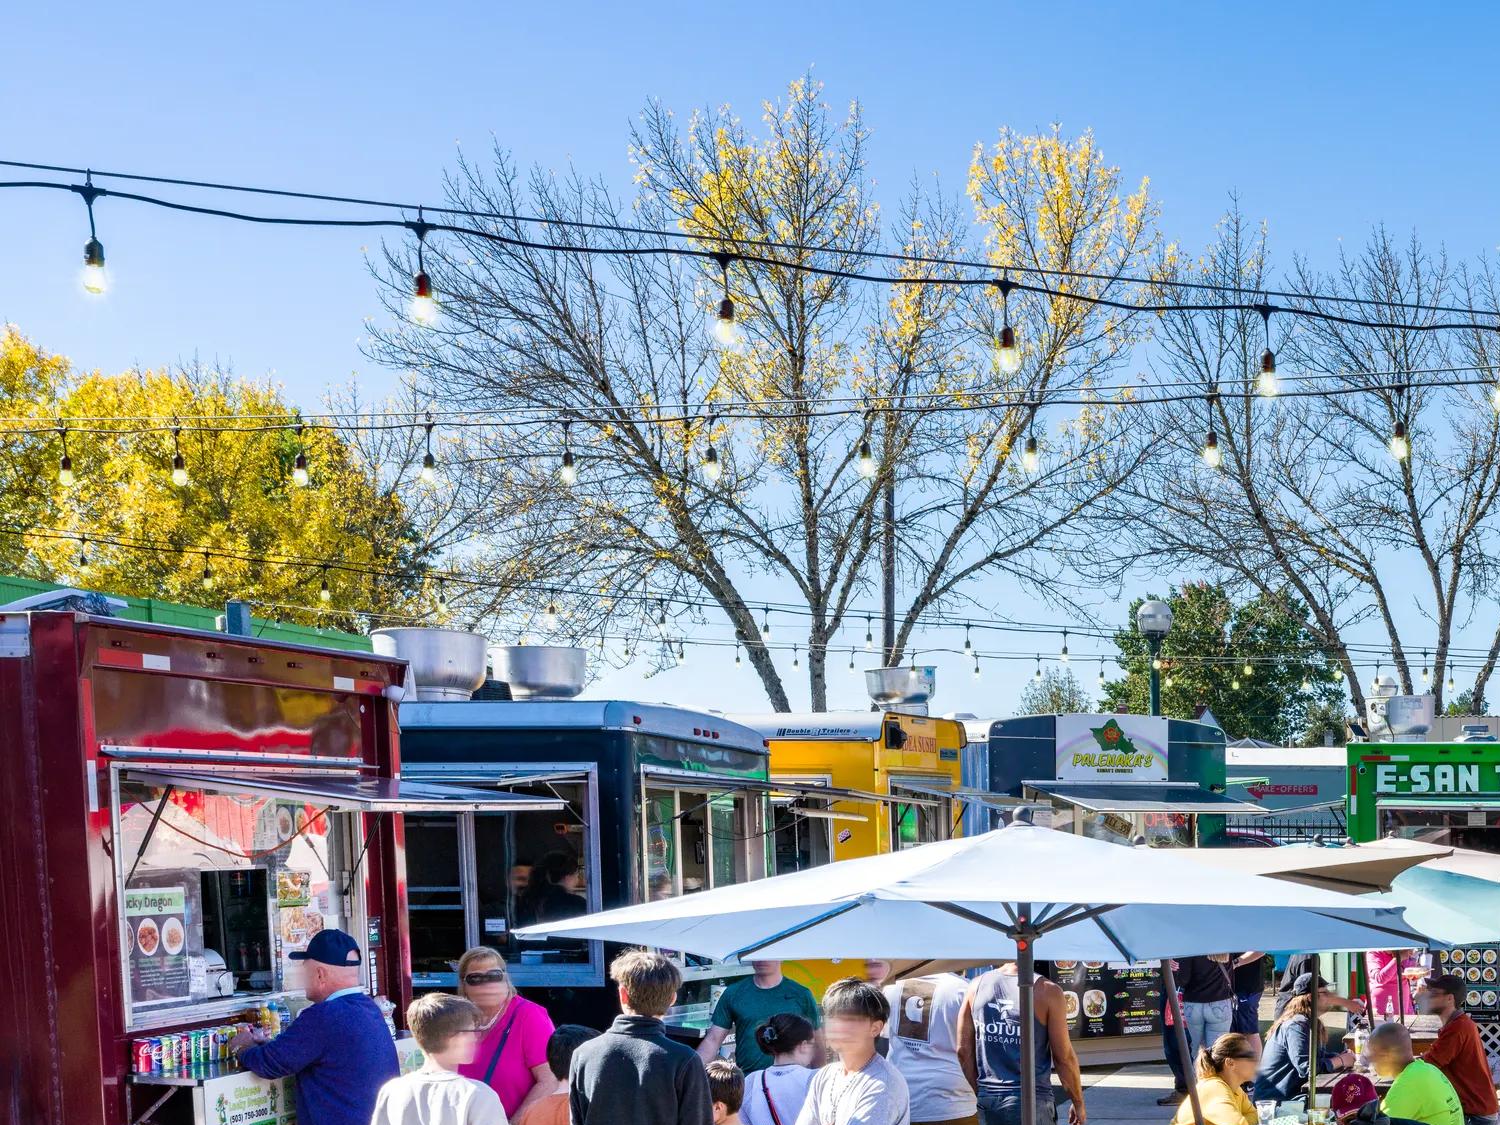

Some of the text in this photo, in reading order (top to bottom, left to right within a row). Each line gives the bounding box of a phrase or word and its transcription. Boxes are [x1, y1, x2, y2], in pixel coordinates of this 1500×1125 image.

[1072, 752, 1153, 768] PALENAKA'S
[1376, 764, 1480, 793] E-SAN
[144, 896, 173, 912] Dragon
